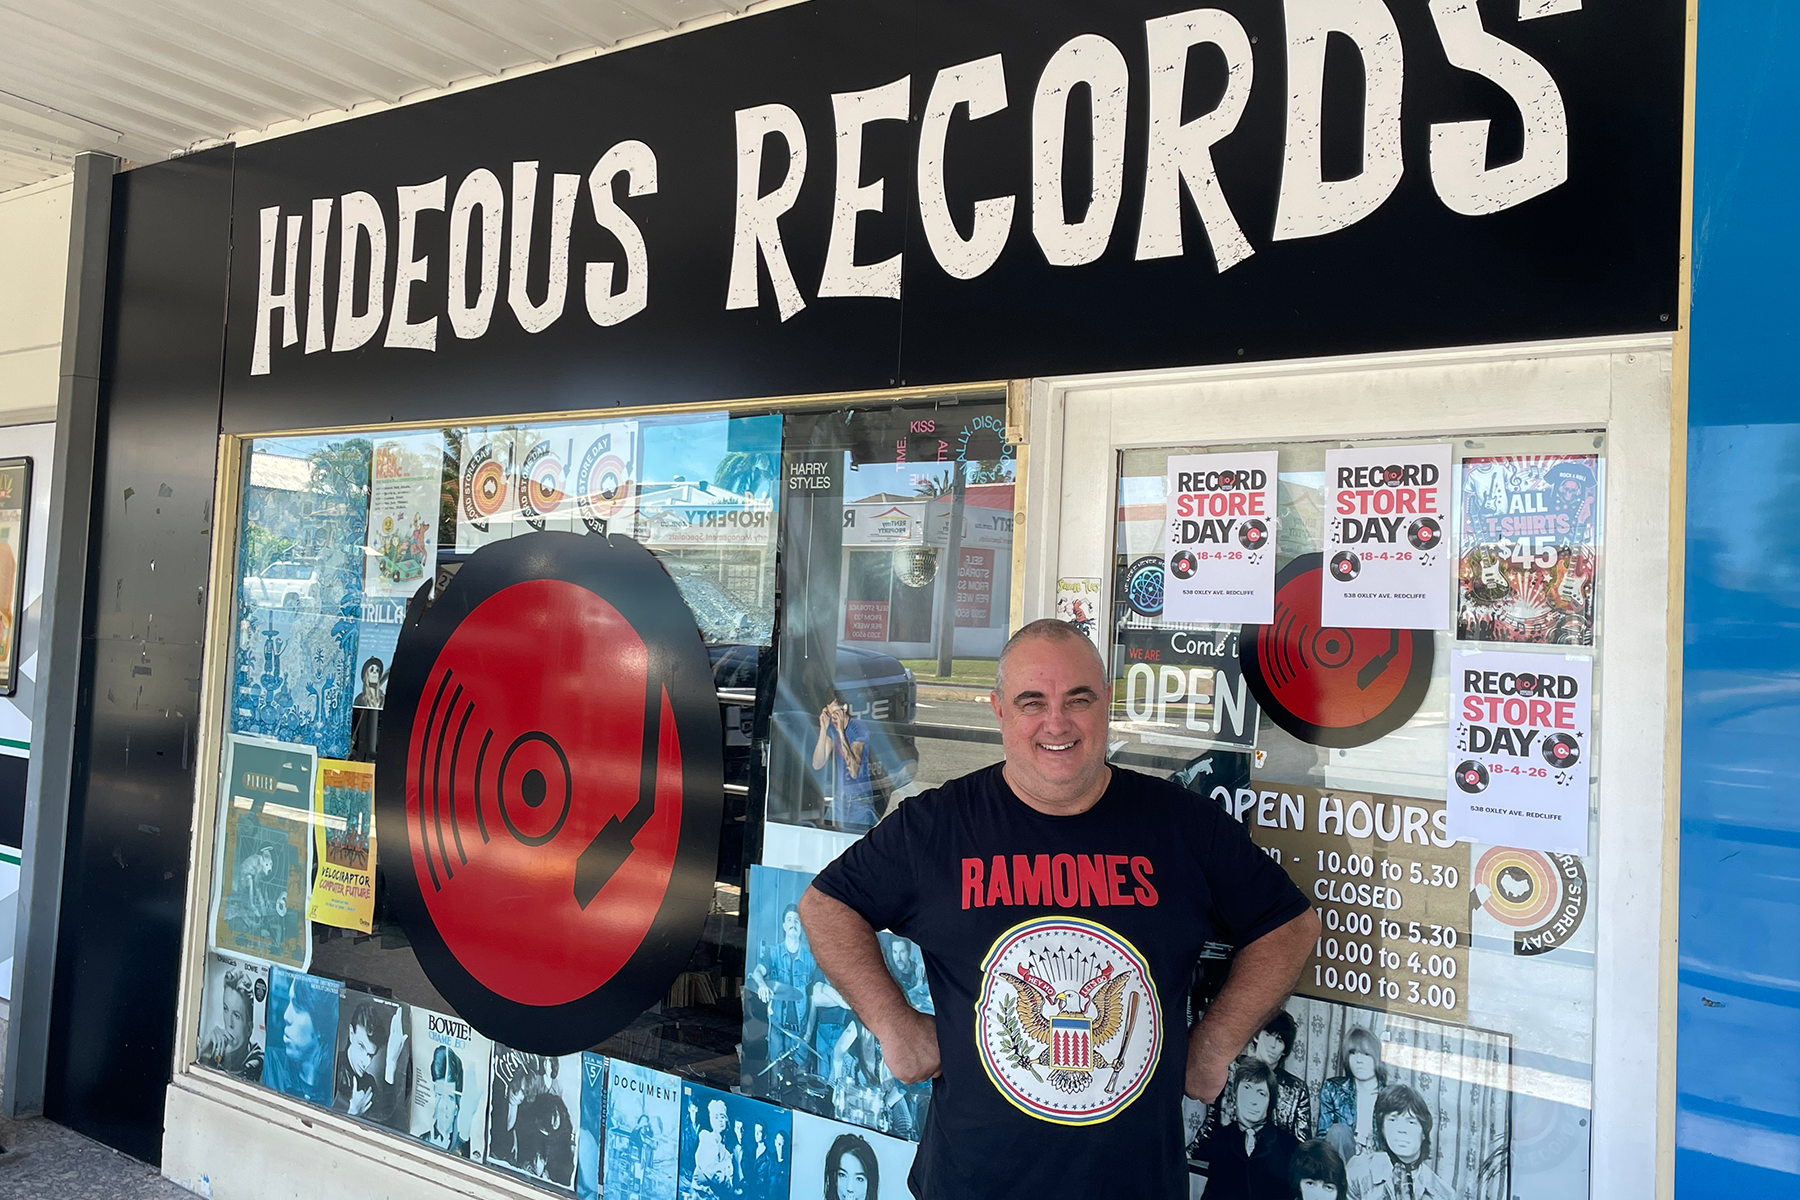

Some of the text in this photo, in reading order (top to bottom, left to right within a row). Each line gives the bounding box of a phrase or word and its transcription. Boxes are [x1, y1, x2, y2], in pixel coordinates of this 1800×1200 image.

[250, 0, 1582, 376] HIDEOUS RECORDS
[910, 419, 935, 433] KISS
[896, 436, 907, 473] TIME.
[937, 439, 949, 465] ALL
[464, 462, 478, 495] STORE
[475, 445, 491, 463] DAY
[520, 460, 533, 494] STORE
[531, 444, 548, 460] DAY
[790, 462, 828, 475] HARRY
[1178, 469, 1267, 492] RECORD
[1338, 464, 1439, 488] RECORD
[578, 437, 608, 533] RECORD STORE DAY
[789, 476, 831, 489] STYLES
[1177, 492, 1265, 517] STORE
[1337, 488, 1437, 515] STORE
[1509, 493, 1548, 514] ALL
[1182, 518, 1236, 544] DAY
[1342, 517, 1405, 544] DAY
[1486, 514, 1570, 537] T-SHIRTS
[1197, 552, 1243, 560] 18-4-26
[1360, 552, 1412, 561] 18-4-26
[1498, 536, 1558, 569] $45
[1129, 648, 1161, 661] WE ARE
[1171, 632, 1225, 656] Come
[1464, 670, 1578, 699] RECORD
[1126, 663, 1247, 736] OPEN
[1463, 695, 1576, 730] STORE
[1469, 725, 1539, 757] DAY
[247, 773, 273, 791] PIXIES
[1488, 764, 1547, 778] 18-4-26
[1209, 785, 1457, 848] OPEN HOURS
[1526, 812, 1562, 821] REDCLIFFE
[321, 866, 370, 888] VELOCIRAPTOR
[961, 853, 1159, 910] RAMONES
[1317, 850, 1374, 877] 10.00
[1380, 859, 1402, 881] to
[1409, 862, 1459, 888] 5.30
[320, 879, 371, 900] COMPUTER FUTURE
[1313, 879, 1401, 910] CLOSED
[1554, 884, 1582, 937] STORE
[1315, 907, 1457, 949] 10.00 to 5.30
[1521, 930, 1556, 951] DAY
[1315, 937, 1457, 979] 10.00 to 4.00
[1028, 976, 1053, 995] HEY HO
[1315, 965, 1456, 1010] 10.00 to 3.00
[428, 1014, 472, 1041] BOWIE!
[590, 1066, 596, 1078] 5
[614, 1075, 677, 1102] DOCUMENT
